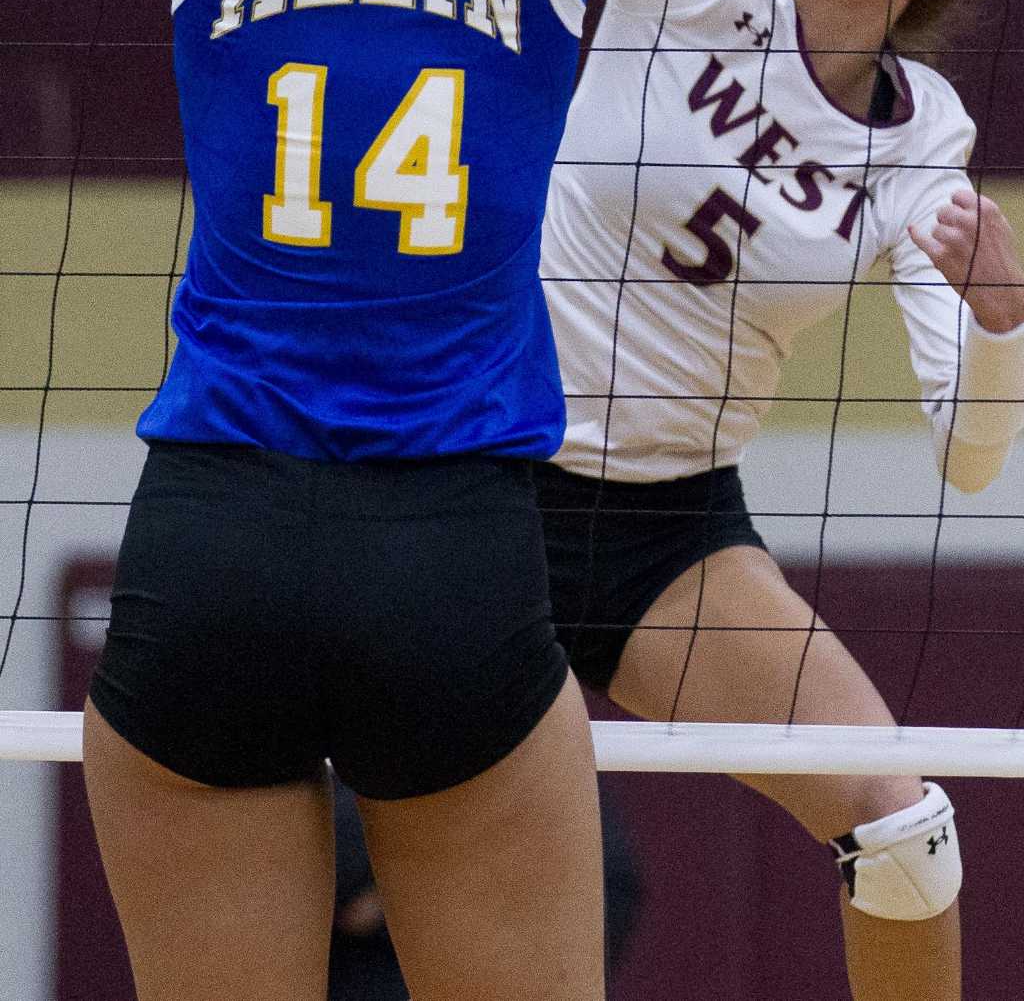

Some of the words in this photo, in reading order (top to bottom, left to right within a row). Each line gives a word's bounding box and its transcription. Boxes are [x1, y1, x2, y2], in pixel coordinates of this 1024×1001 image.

[262, 62, 470, 256] 14
[661, 186, 763, 287] 5
[687, 54, 874, 243] WEST
